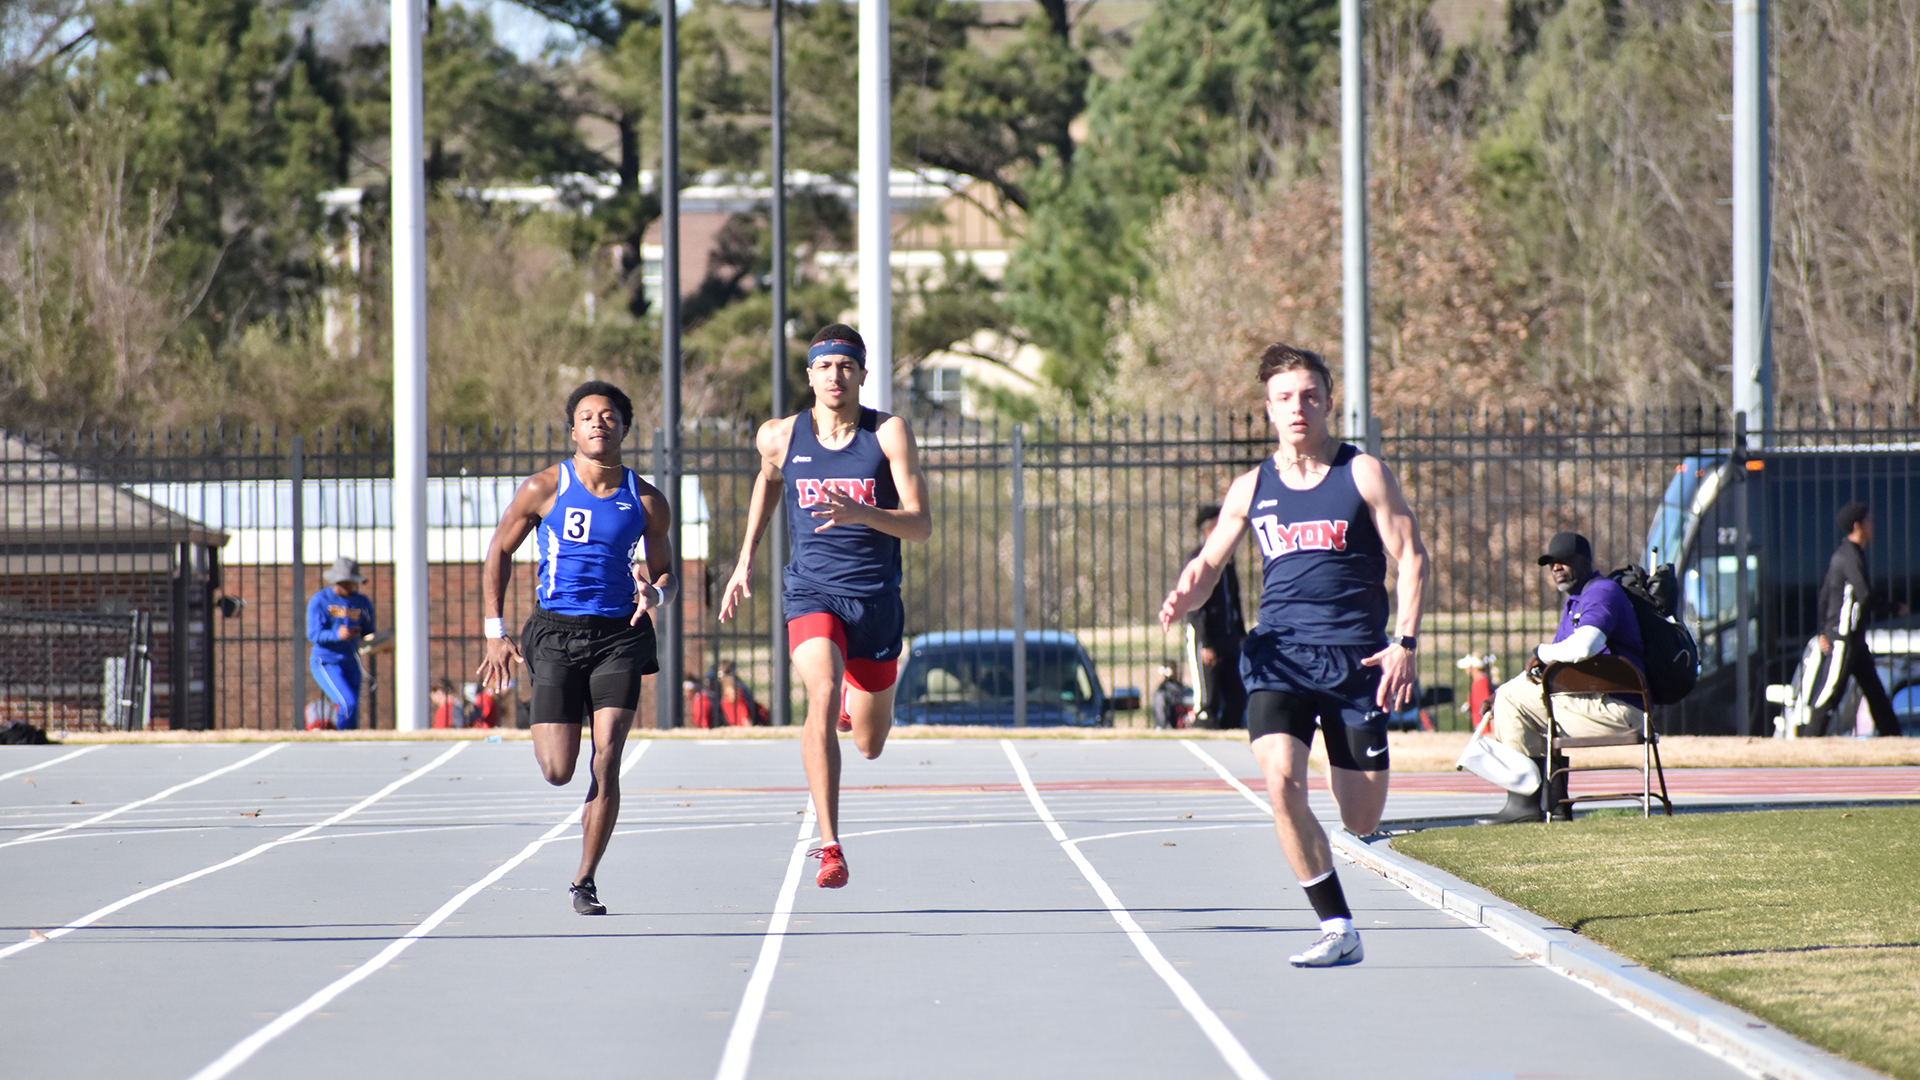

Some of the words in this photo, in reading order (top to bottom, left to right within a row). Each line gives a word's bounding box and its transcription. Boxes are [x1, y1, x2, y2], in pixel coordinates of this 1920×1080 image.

[567, 511, 586, 539] 3
[1258, 521, 1274, 552] 1
[1276, 520, 1348, 554] YON
